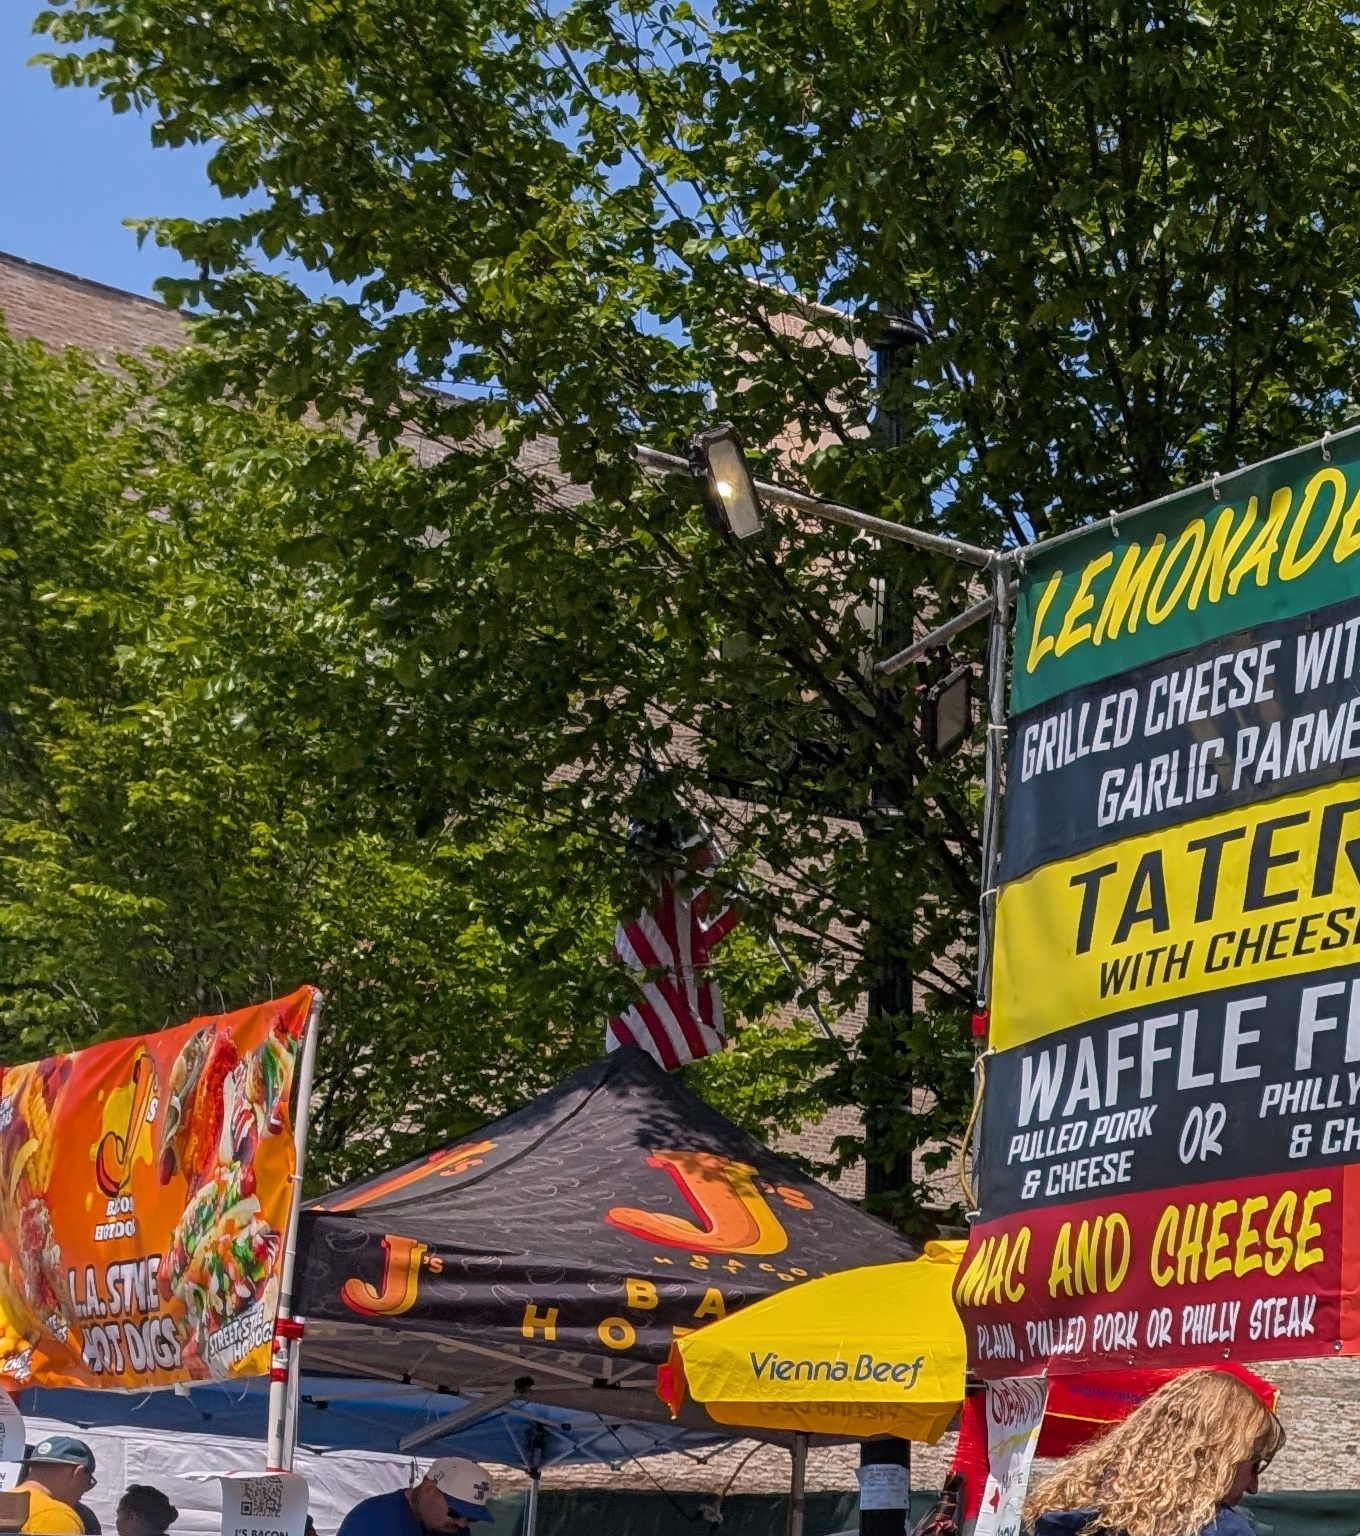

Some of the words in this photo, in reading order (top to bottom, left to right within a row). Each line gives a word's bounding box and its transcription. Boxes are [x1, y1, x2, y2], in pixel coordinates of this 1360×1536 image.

[1021, 688, 1139, 783] GRILLED
[1143, 640, 1282, 737] CHEESE
[1097, 738, 1225, 827] GARLIC
[1100, 940, 1196, 1000] WITH
[1017, 995, 1267, 1128] WAFFLE
[1007, 1120, 1089, 1165] PULLED
[1090, 1103, 1159, 1150] PORK
[1178, 1102, 1227, 1164] OR
[1289, 1125, 1312, 1159] &
[1021, 1171, 1041, 1199] &
[1044, 1150, 1135, 1197] CHEESE
[955, 1226, 1031, 1307] MAC
[1049, 1212, 1132, 1298] AND
[1151, 1188, 1332, 1289] CHEESE
[976, 1323, 1025, 1363] PLAIN,
[1027, 1314, 1087, 1357] PULLED
[1092, 1310, 1138, 1350] PORK
[1146, 1307, 1174, 1347] OR
[1181, 1301, 1242, 1343] PHILLY
[1249, 1295, 1317, 1338] STEAK
[750, 1352, 848, 1382] Vienna
[854, 1354, 926, 1391] Beef
